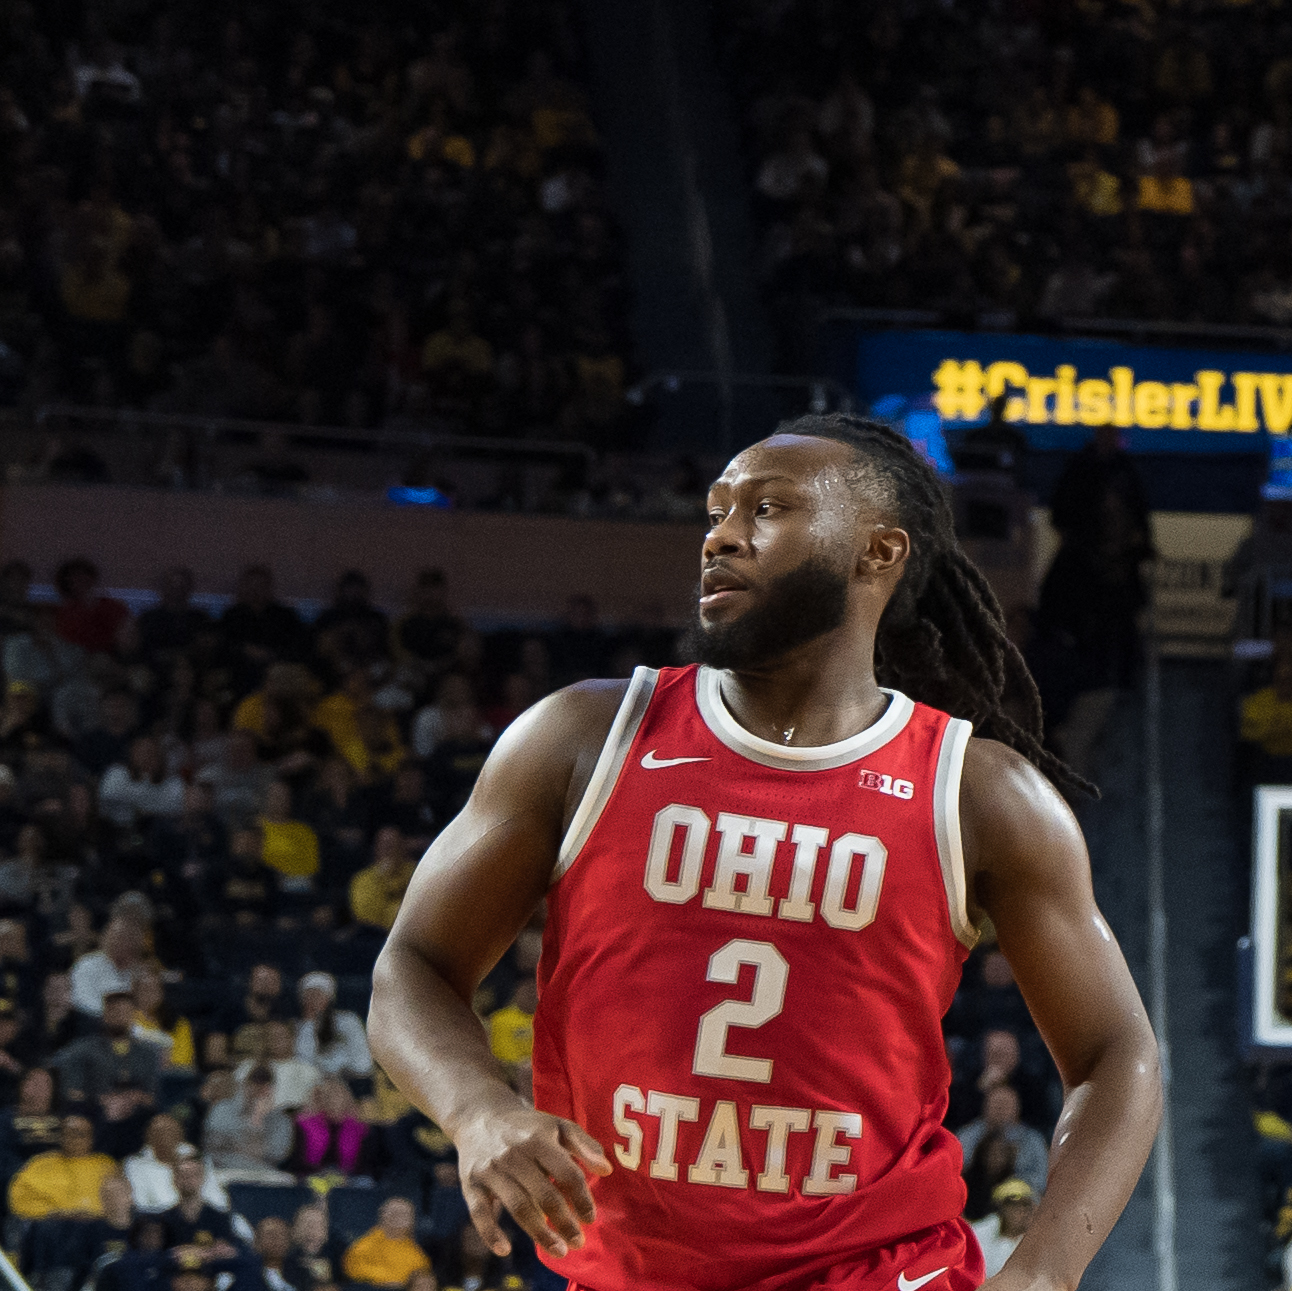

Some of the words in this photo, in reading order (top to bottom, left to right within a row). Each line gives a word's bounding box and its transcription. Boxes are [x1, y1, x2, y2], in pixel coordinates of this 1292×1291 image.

[643, 803, 888, 931] OHIO
[692, 938, 790, 1084] 2
[613, 1084, 862, 1196] STATE
